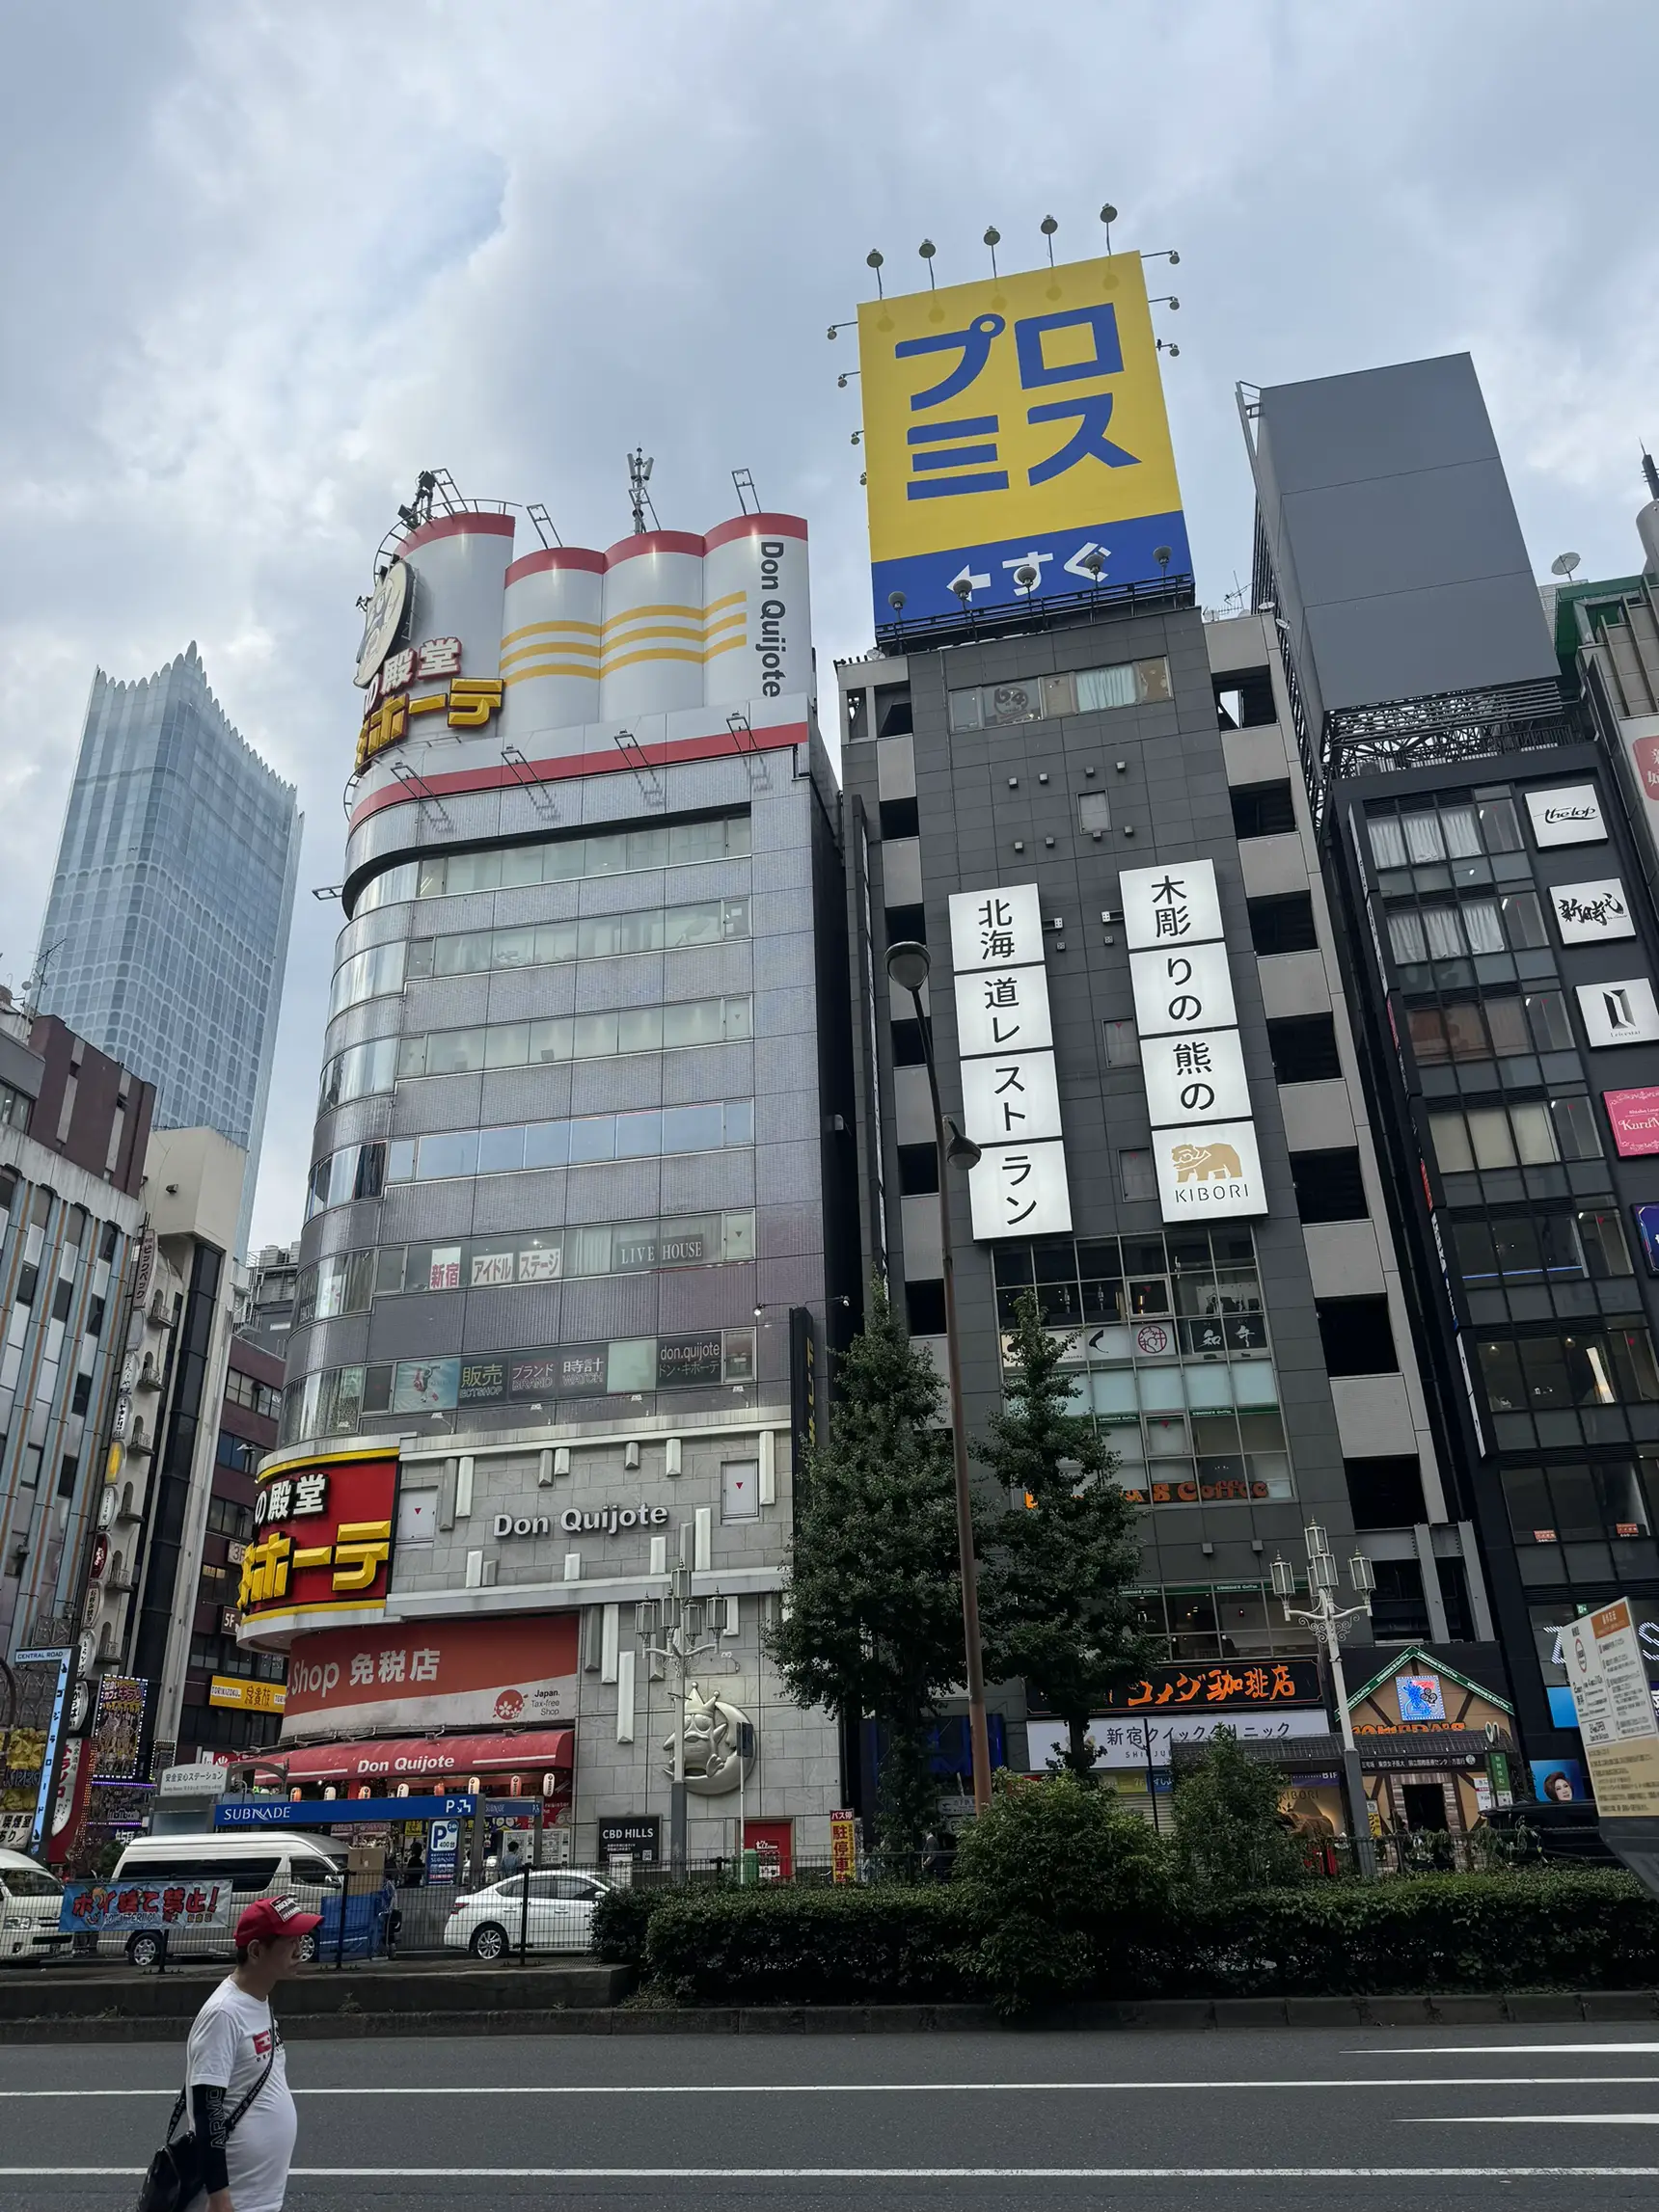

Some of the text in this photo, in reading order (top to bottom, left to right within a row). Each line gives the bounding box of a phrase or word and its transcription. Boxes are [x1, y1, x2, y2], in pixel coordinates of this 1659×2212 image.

[895, 303, 1125, 412] プロ
[907, 392, 1142, 500] ミス
[1001, 542, 1111, 596] すぐ
[755, 542, 786, 697] Don Quijote
[1151, 875, 1215, 1111] 木彫りの熊の
[977, 898, 1038, 1226] 北海道レストラン
[1175, 1183, 1249, 1203] KIBORI
[621, 1241, 702, 1264] LIVE HOUSE
[430, 1252, 559, 1288] 新宿 アイドル ステージ
[661, 1342, 721, 1362] don.quijote
[461, 1362, 503, 1388] 販売
[512, 1362, 555, 1380] ブランド
[563, 1358, 605, 1374] 時計
[512, 1376, 553, 1391] BRAND
[255, 1473, 329, 1525] の殿堂
[493, 1502, 668, 1537] Don Quijote
[224, 1613, 235, 1628] 5F
[291, 1659, 340, 1698] Shop
[349, 1648, 442, 1686] 免税店
[1128, 1664, 1295, 1707] コメダ珈琲店
[531, 1698, 560, 1709] Tax-free
[540, 1708, 559, 1716] Shop
[357, 1755, 455, 1774] Don Quijote
[165, 1771, 224, 1783] 安全安心ステーション
[224, 1806, 291, 1821] SUBNADE
[446, 1800, 454, 1814] P
[831, 1811, 853, 1821] バス停
[433, 1825, 448, 1848] P
[603, 1827, 654, 1839] CBD HILLS
